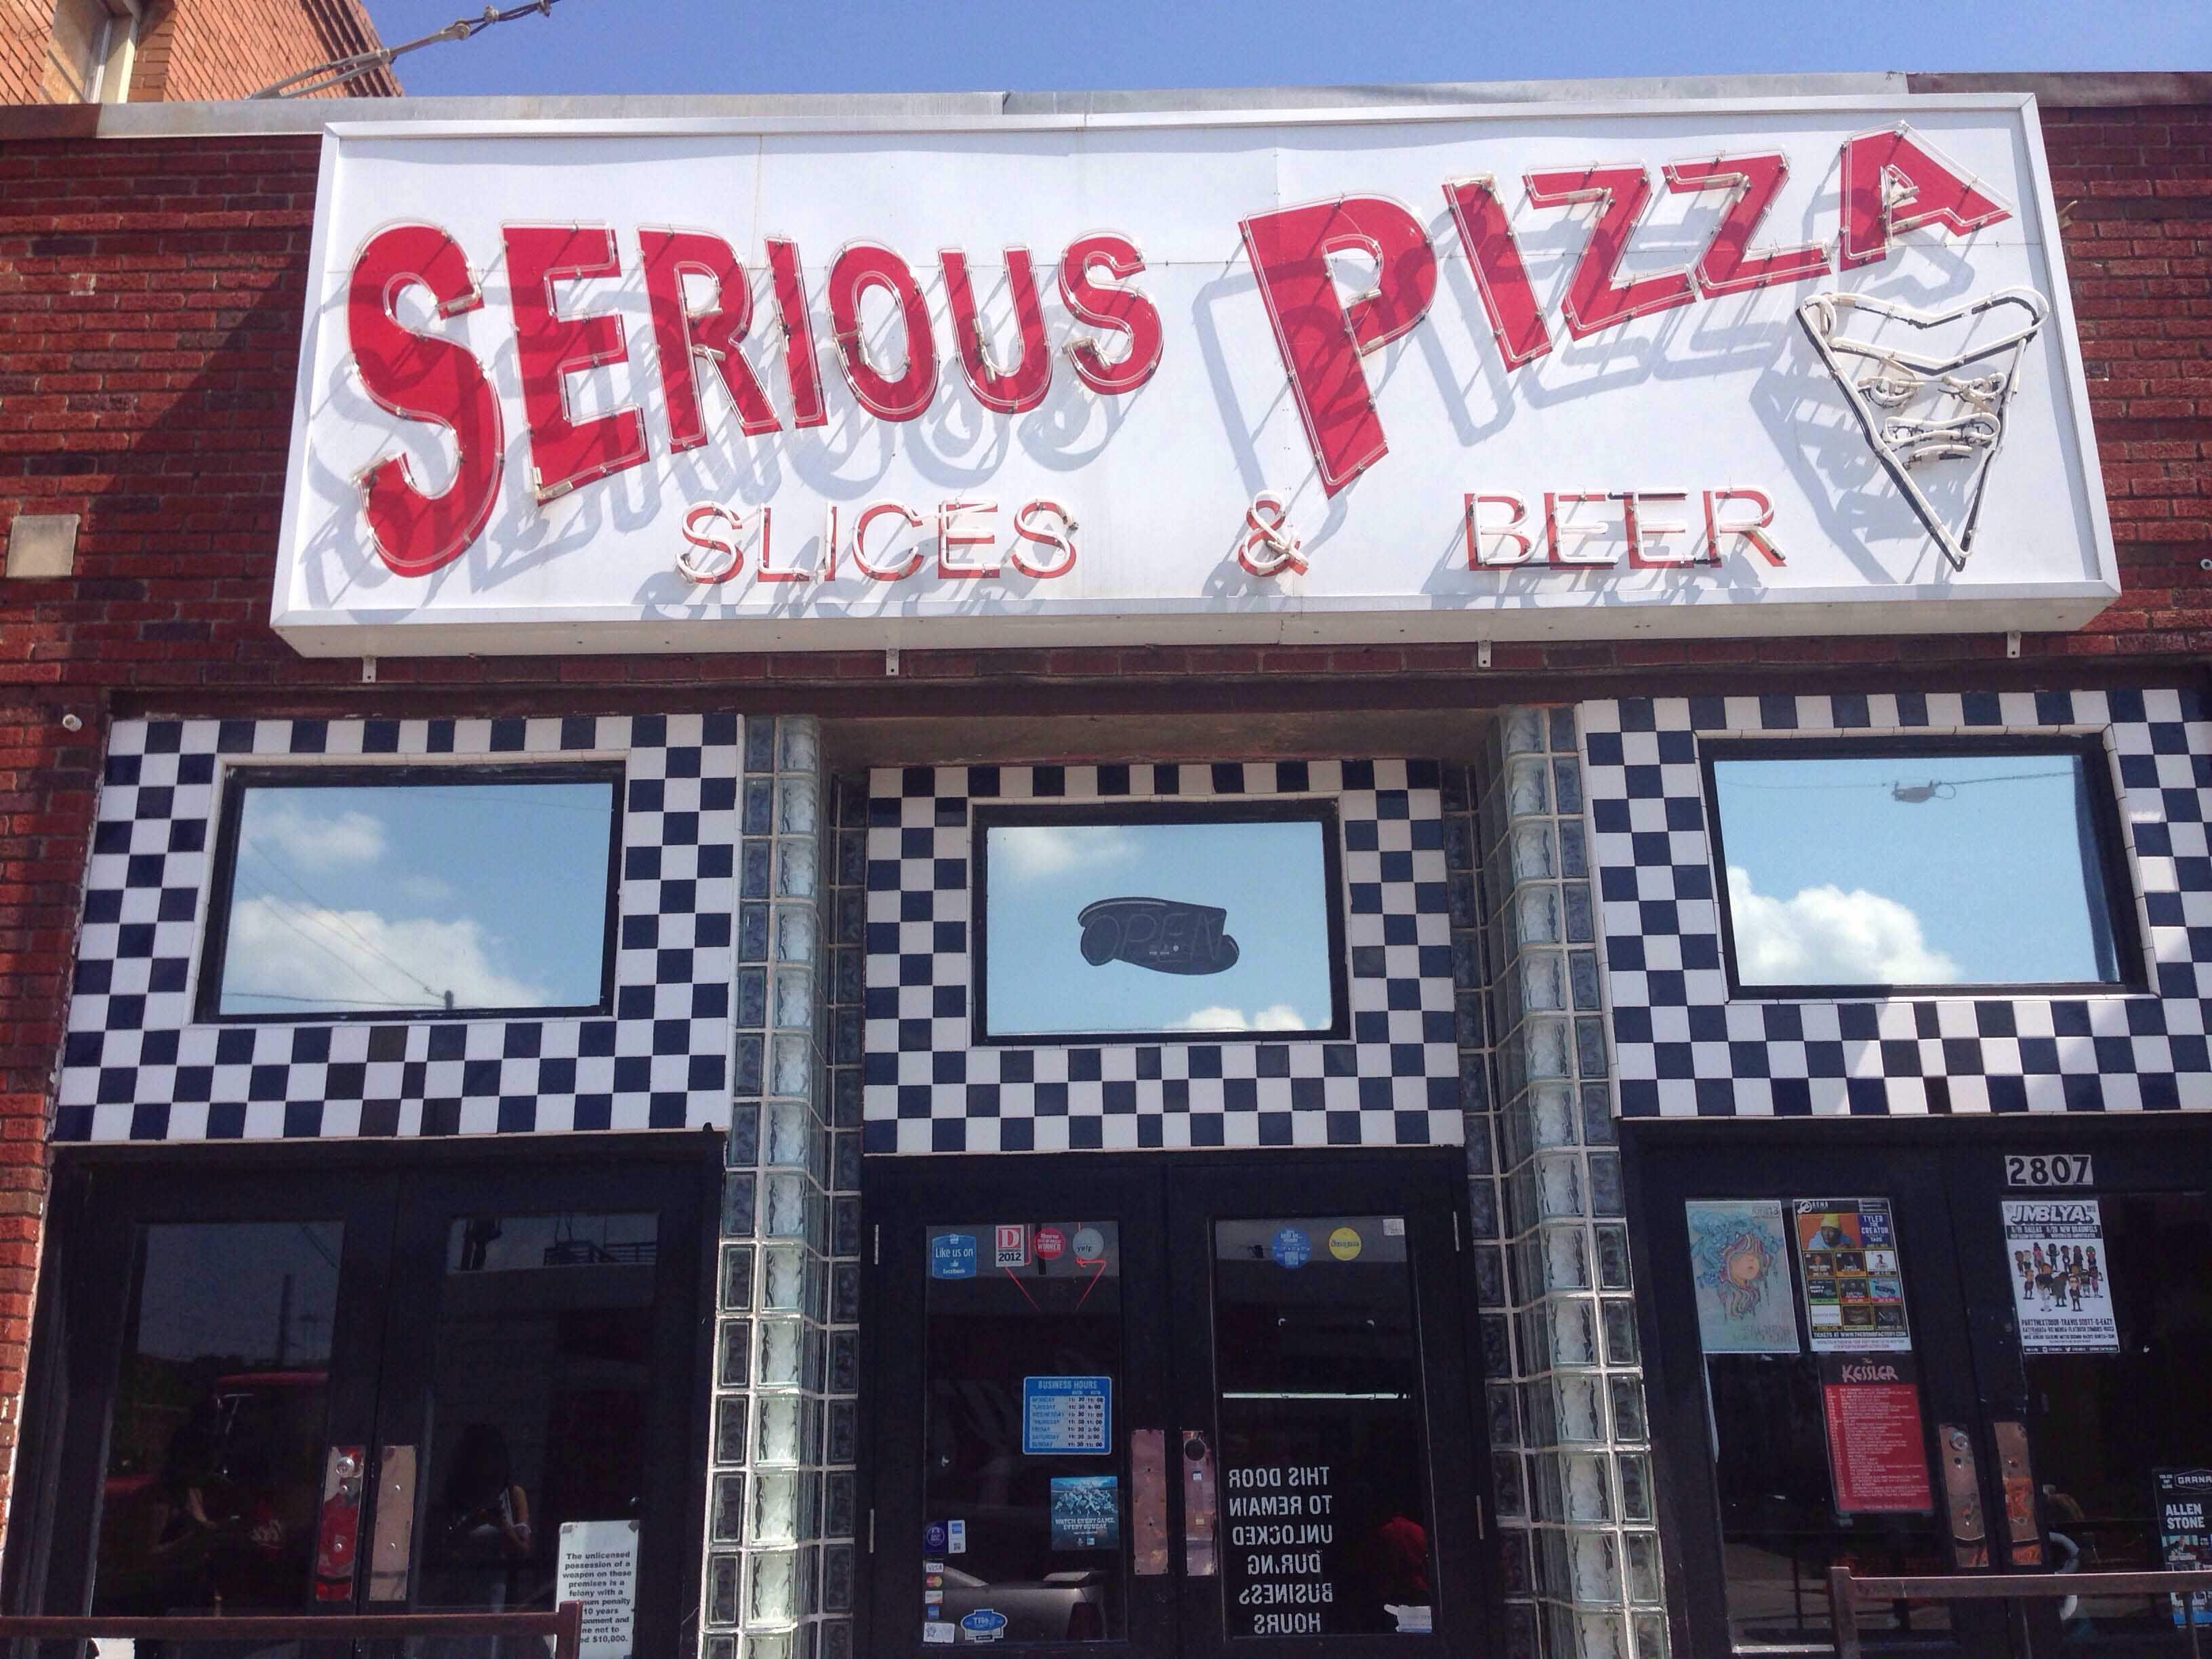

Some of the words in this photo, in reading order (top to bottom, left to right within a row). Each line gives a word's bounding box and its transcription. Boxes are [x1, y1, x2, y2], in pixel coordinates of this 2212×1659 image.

[348, 218, 1164, 578] SERIOUS
[1239, 121, 2013, 498] PIZZA
[676, 498, 1079, 583] SLICES
[1238, 489, 1310, 578] &
[1465, 485, 1787, 571] BEER
[2009, 1156, 2090, 1185] 2807
[1001, 1229, 1020, 1248] D
[935, 1247, 950, 1258] Like
[952, 1248, 961, 1258] us
[964, 1248, 974, 1258] on
[1077, 1245, 1092, 1253] yelp
[998, 1252, 1022, 1262] 2012
[1842, 1364, 1899, 1383] KESSLER
[1038, 1380, 1072, 1389] BUSINESS
[1073, 1380, 1098, 1389] HOURS
[2166, 1502, 2202, 1516] ALLEN
[2167, 1516, 2205, 1529] STONE
[586, 1551, 630, 1559] unlicensed
[565, 1561, 611, 1570] possession
[614, 1560, 623, 1568] of
[562, 1572, 594, 1580] weapon
[569, 1580, 607, 1589] premises
[569, 1589, 594, 1597] felony
[602, 1598, 631, 1606] penalty
[592, 1635, 628, 1643] $10,000.
